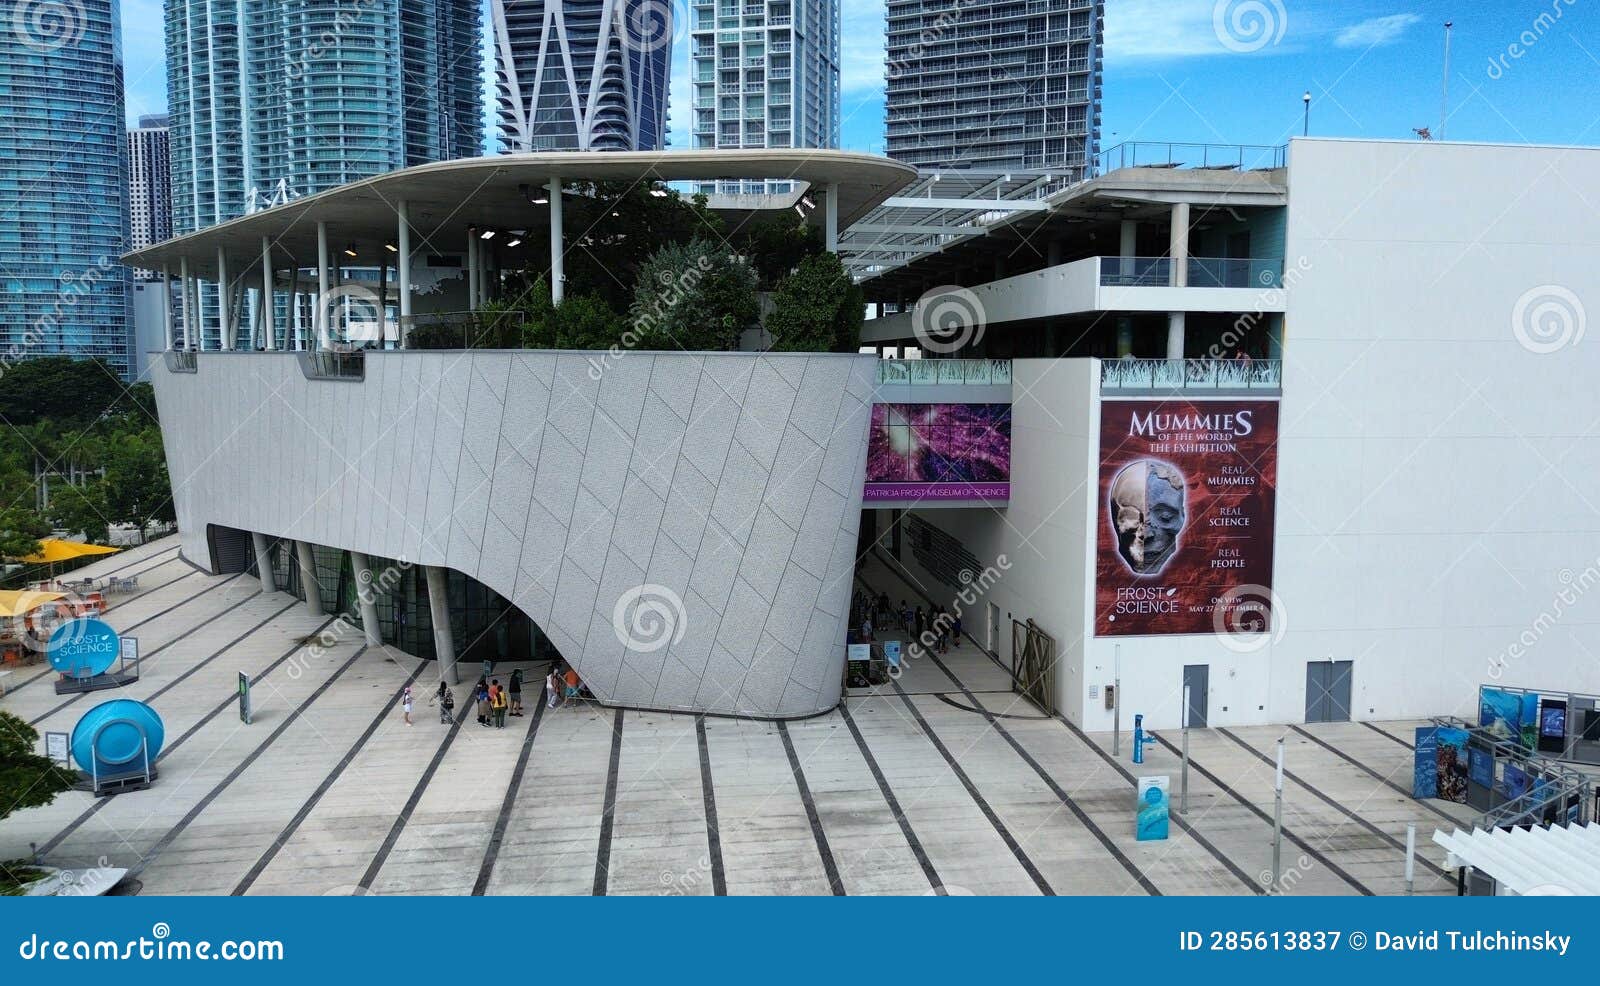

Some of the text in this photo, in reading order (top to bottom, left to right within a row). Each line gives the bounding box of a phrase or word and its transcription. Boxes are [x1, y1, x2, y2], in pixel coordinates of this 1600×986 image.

[1128, 410, 1252, 436] MUMMIES
[1158, 433, 1233, 441] OF THE WORLD
[1149, 443, 1237, 452] THE EXHIBITION
[1221, 466, 1244, 475] REAL
[1207, 477, 1255, 485] MUMMIES
[866, 488, 1007, 497] PATRICIA FROST MUSEUM OF SCIENCE
[1220, 507, 1242, 516] REAL
[1209, 518, 1250, 526] SCIENCE
[1218, 549, 1240, 557] REAL
[1211, 559, 1246, 568] PEOPLE
[1117, 587, 1165, 600] FROST
[1116, 600, 1179, 613] SCIENCE
[60, 634, 100, 647] FROST
[60, 642, 113, 657] SCIENCE
